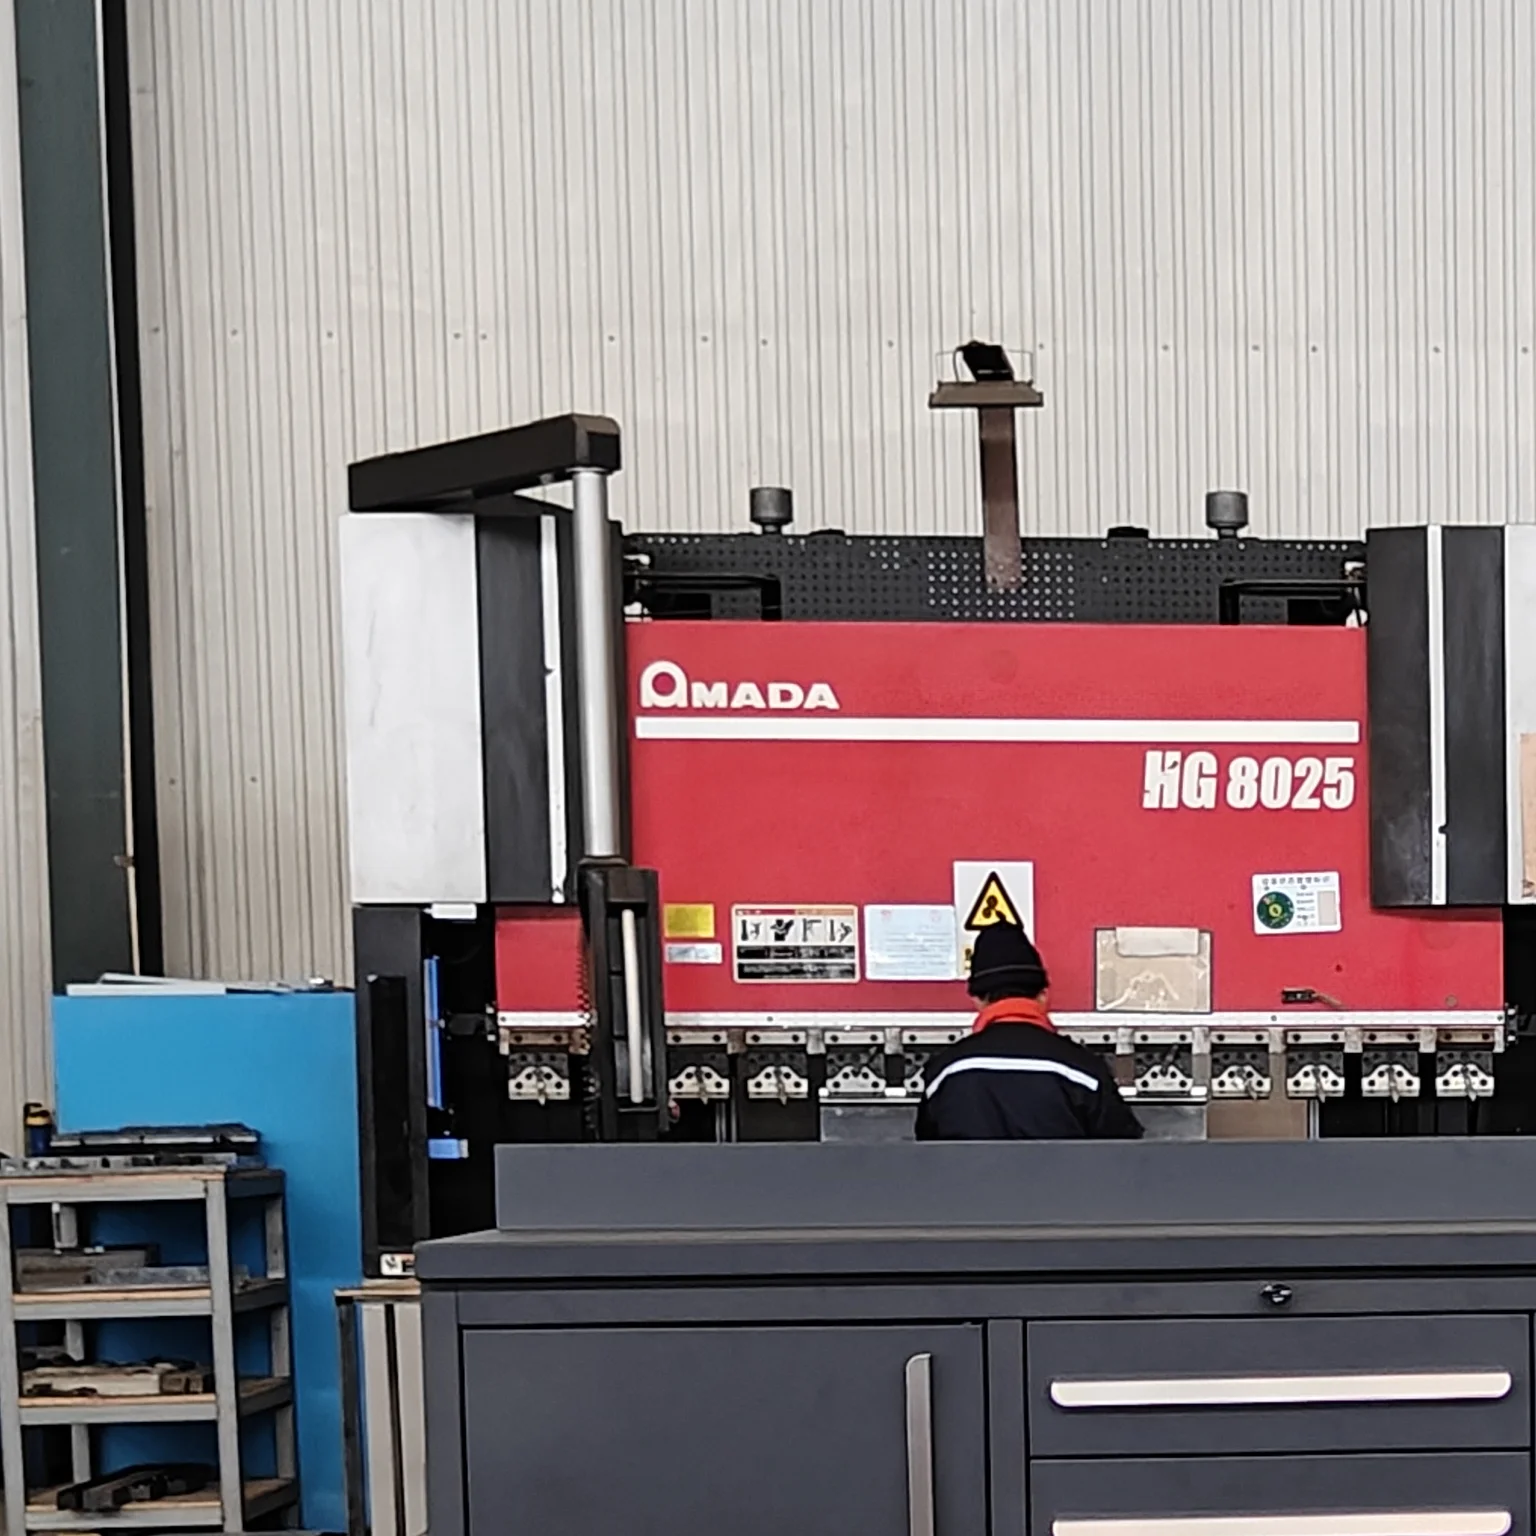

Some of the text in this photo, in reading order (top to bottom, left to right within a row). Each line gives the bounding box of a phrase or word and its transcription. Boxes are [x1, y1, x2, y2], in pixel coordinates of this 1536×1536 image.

[640, 660, 840, 709] AMADA
[1142, 750, 1355, 809] HG 8025
